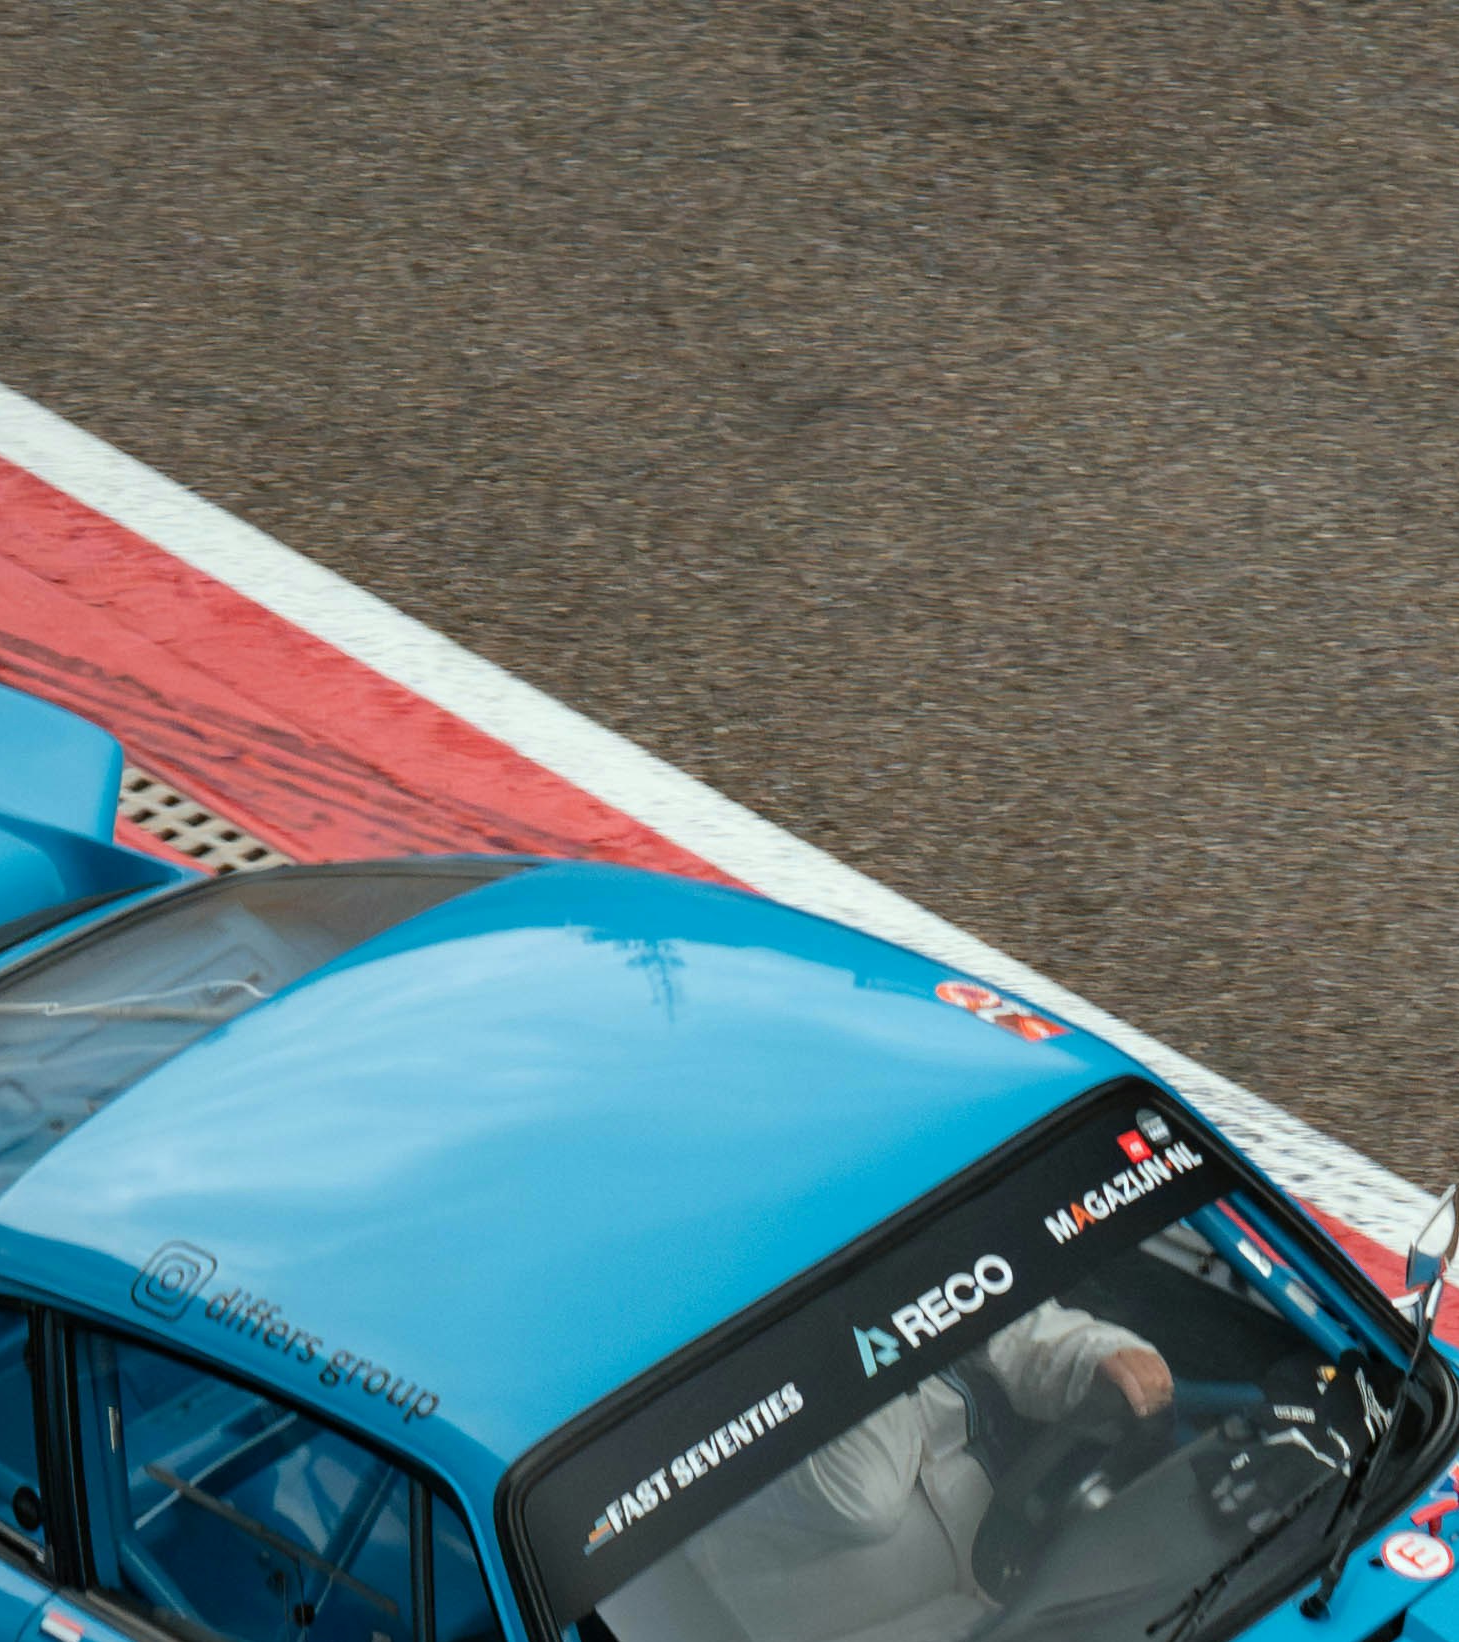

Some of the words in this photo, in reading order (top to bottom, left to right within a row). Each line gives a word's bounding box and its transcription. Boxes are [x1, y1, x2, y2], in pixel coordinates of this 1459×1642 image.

[204, 1287, 324, 1366] differs
[318, 1348, 441, 1424] group
[891, 1254, 1014, 1349] RECO
[605, 1467, 672, 1535] FAST
[670, 1381, 804, 1489] SEVENTIES
